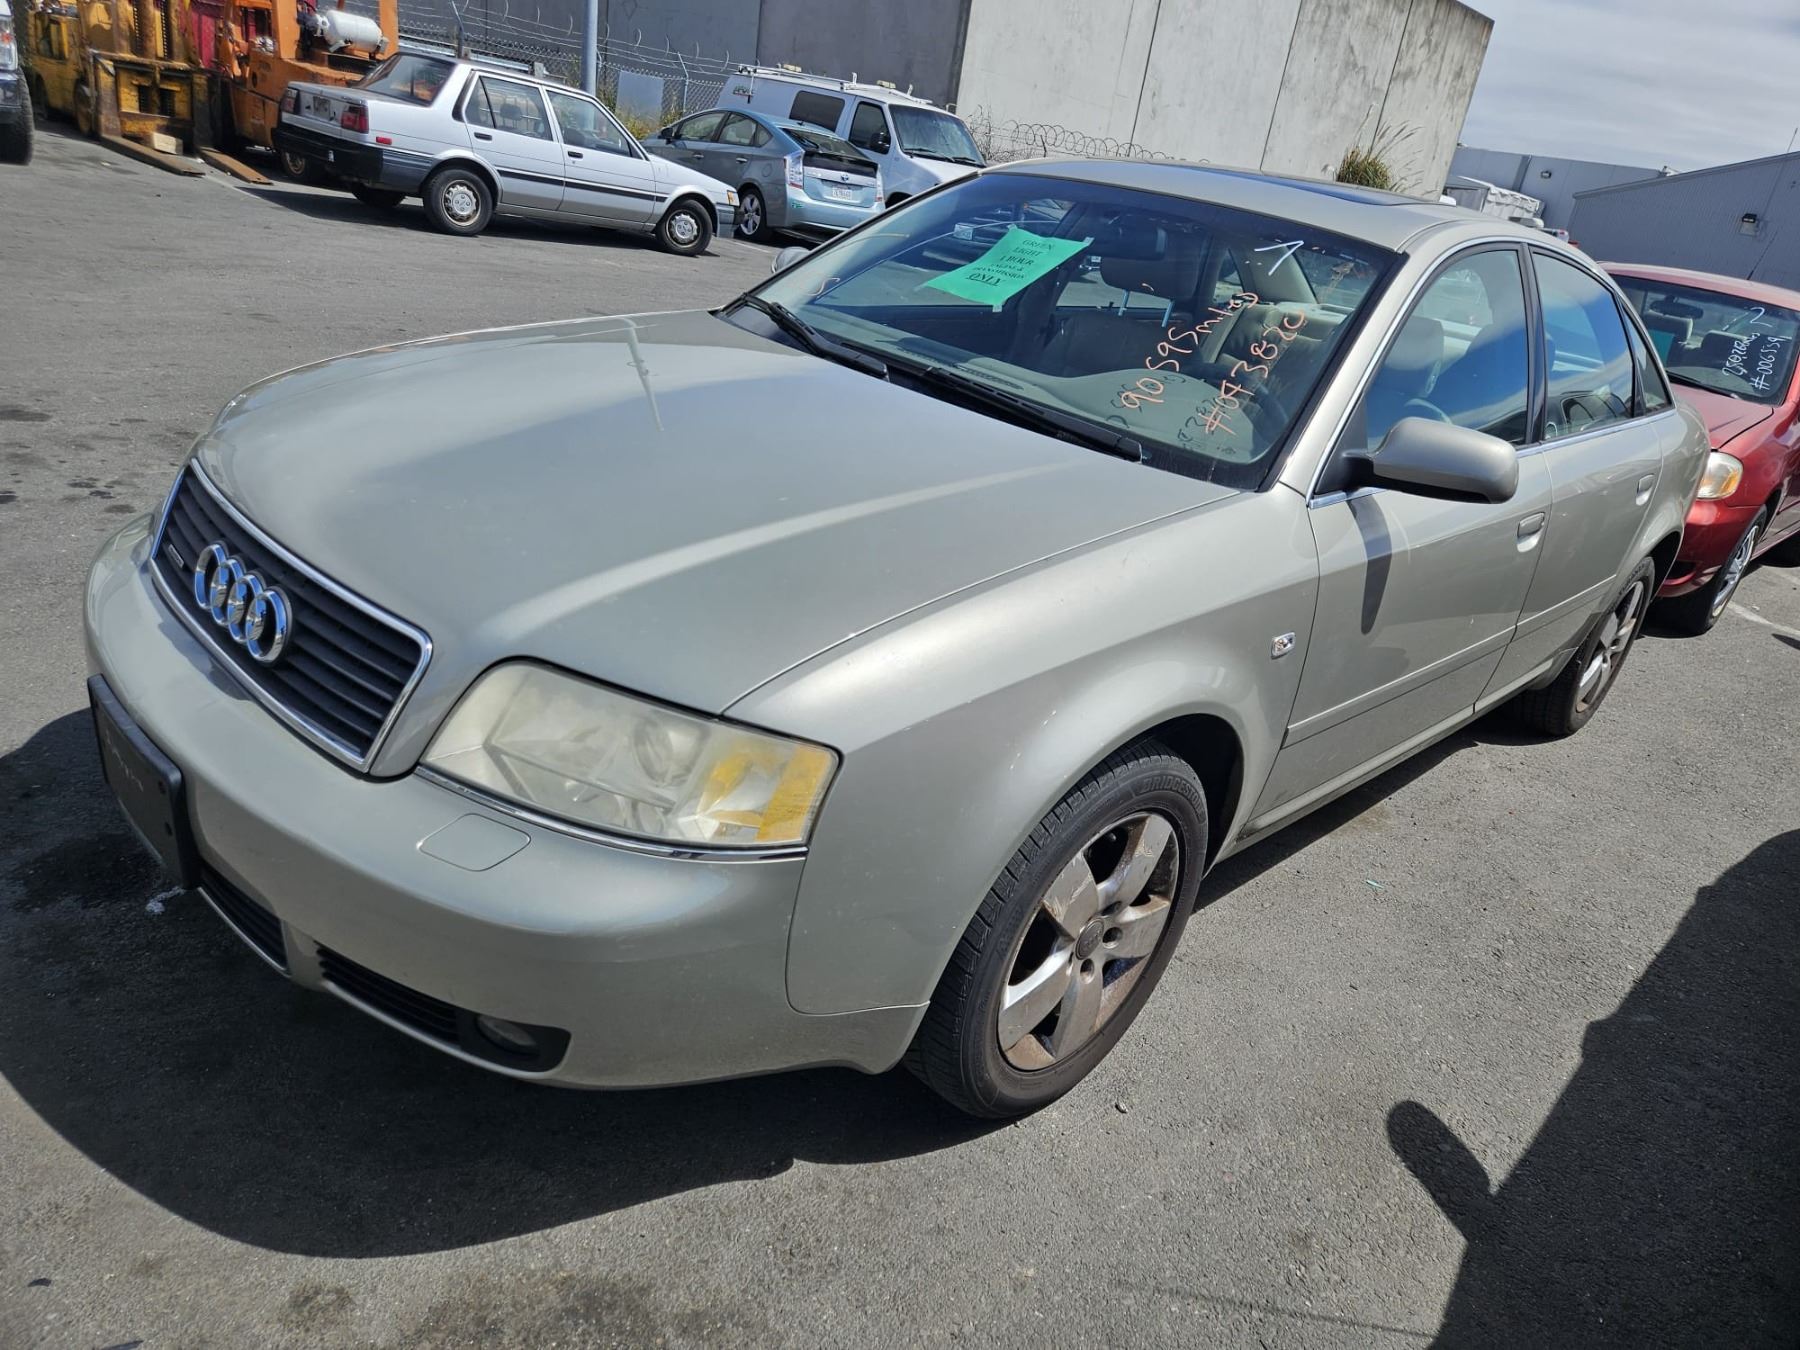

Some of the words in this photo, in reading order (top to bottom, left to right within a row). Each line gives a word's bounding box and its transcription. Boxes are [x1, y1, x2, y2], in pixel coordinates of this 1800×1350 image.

[1012, 246, 1043, 257] LIGHT
[1006, 255, 1034, 266] HOUR
[968, 272, 1005, 284] ONLY
[1750, 306, 1773, 328] 2
